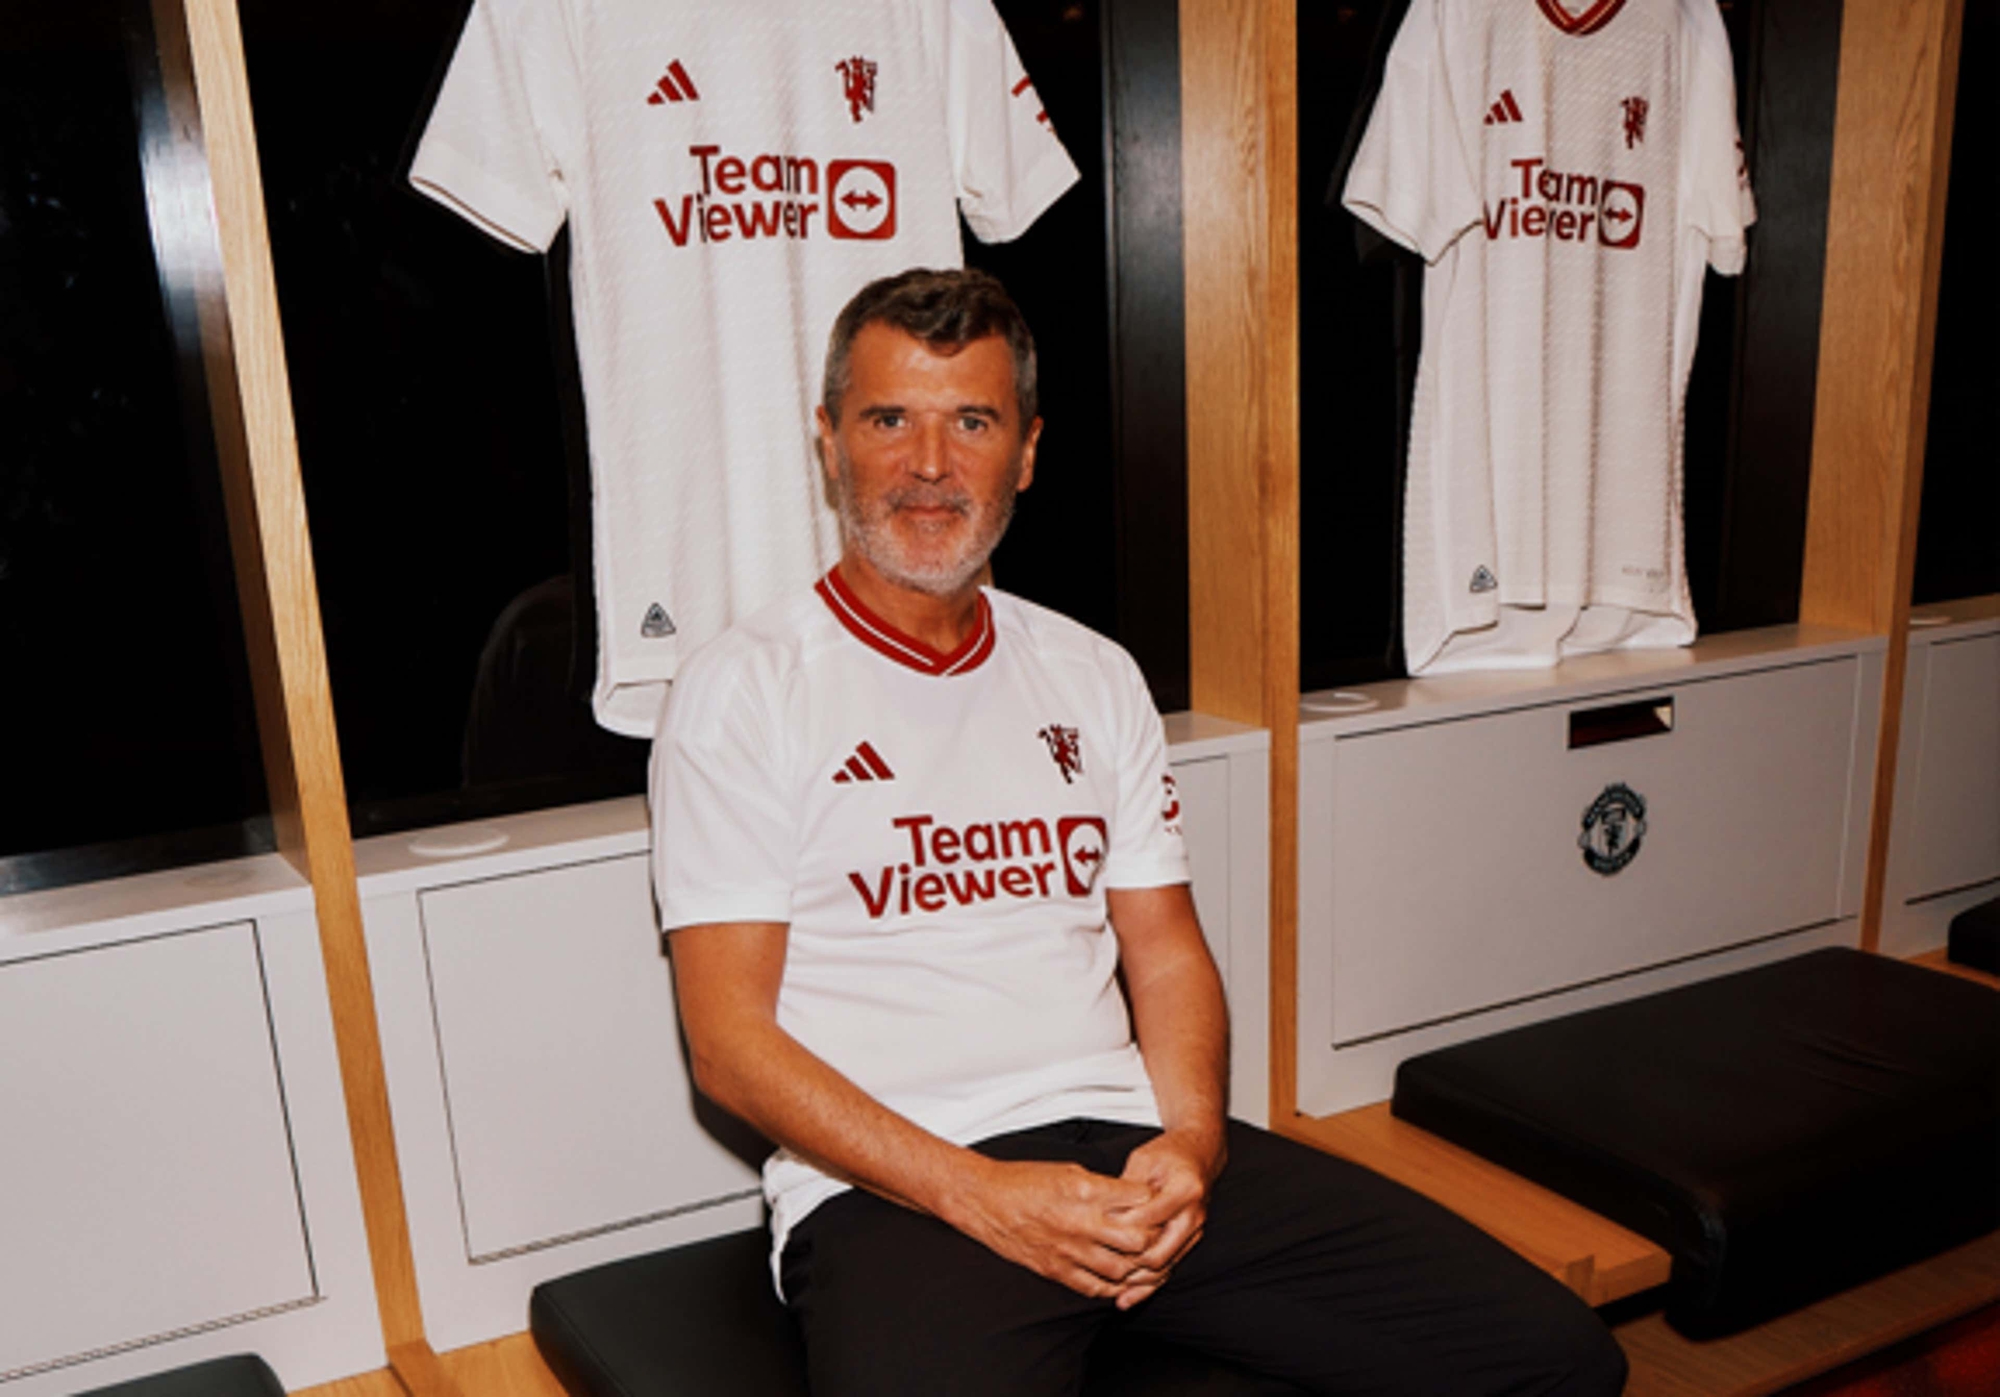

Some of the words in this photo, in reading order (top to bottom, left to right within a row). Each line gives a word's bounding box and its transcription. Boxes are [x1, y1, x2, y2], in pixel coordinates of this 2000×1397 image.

[690, 145, 818, 195] Team
[654, 192, 818, 247] Viewer
[1483, 197, 1595, 242] Vieer
[893, 814, 1052, 867] Team
[848, 862, 1055, 919] Viewer
